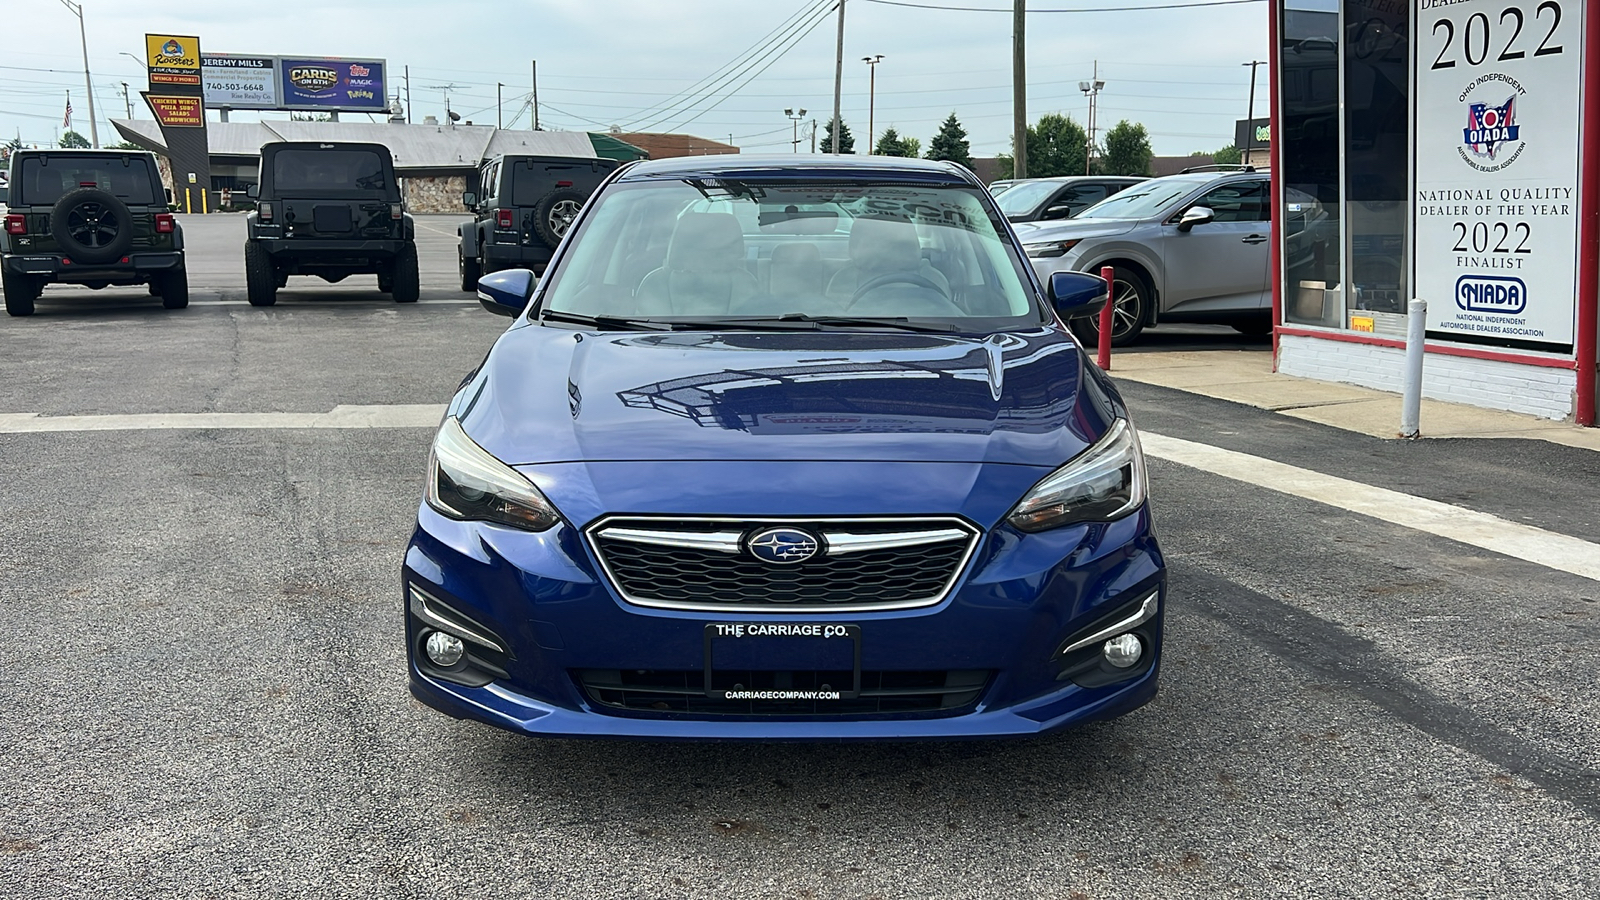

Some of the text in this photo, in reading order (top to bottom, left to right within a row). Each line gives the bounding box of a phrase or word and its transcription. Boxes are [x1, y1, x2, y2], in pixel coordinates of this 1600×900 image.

[1431, 1, 1563, 70] 2022
[153, 53, 195, 66] Roosters
[203, 58, 263, 67] JEREMY MILLS
[291, 69, 337, 82] CARDS
[206, 82, 264, 92] 740-503-6648
[1458, 73, 1527, 103] OHIO INDEPENDENT
[244, 92, 261, 101] Realty
[1470, 127, 1510, 143] OIADA
[1457, 146, 1480, 171] AUTOMOBILE
[1500, 141, 1526, 169] ASSOCIATION
[1418, 187, 1572, 202] NATIONAL QUALITY
[1420, 204, 1570, 216] DEALER OF THE YEAR
[1452, 221, 1532, 254] 2022
[1456, 256, 1524, 269] FINALIST
[1461, 283, 1519, 307] NIADA
[1456, 313, 1526, 326] NATIONAL INDEPENDENT
[1440, 321, 1544, 338] AUTOMOBILE DEALERS ASSOCIATION
[715, 624, 849, 637] THE CARRIAGE CO.
[725, 691, 840, 700] CARRIAGECOMPANY.COM
